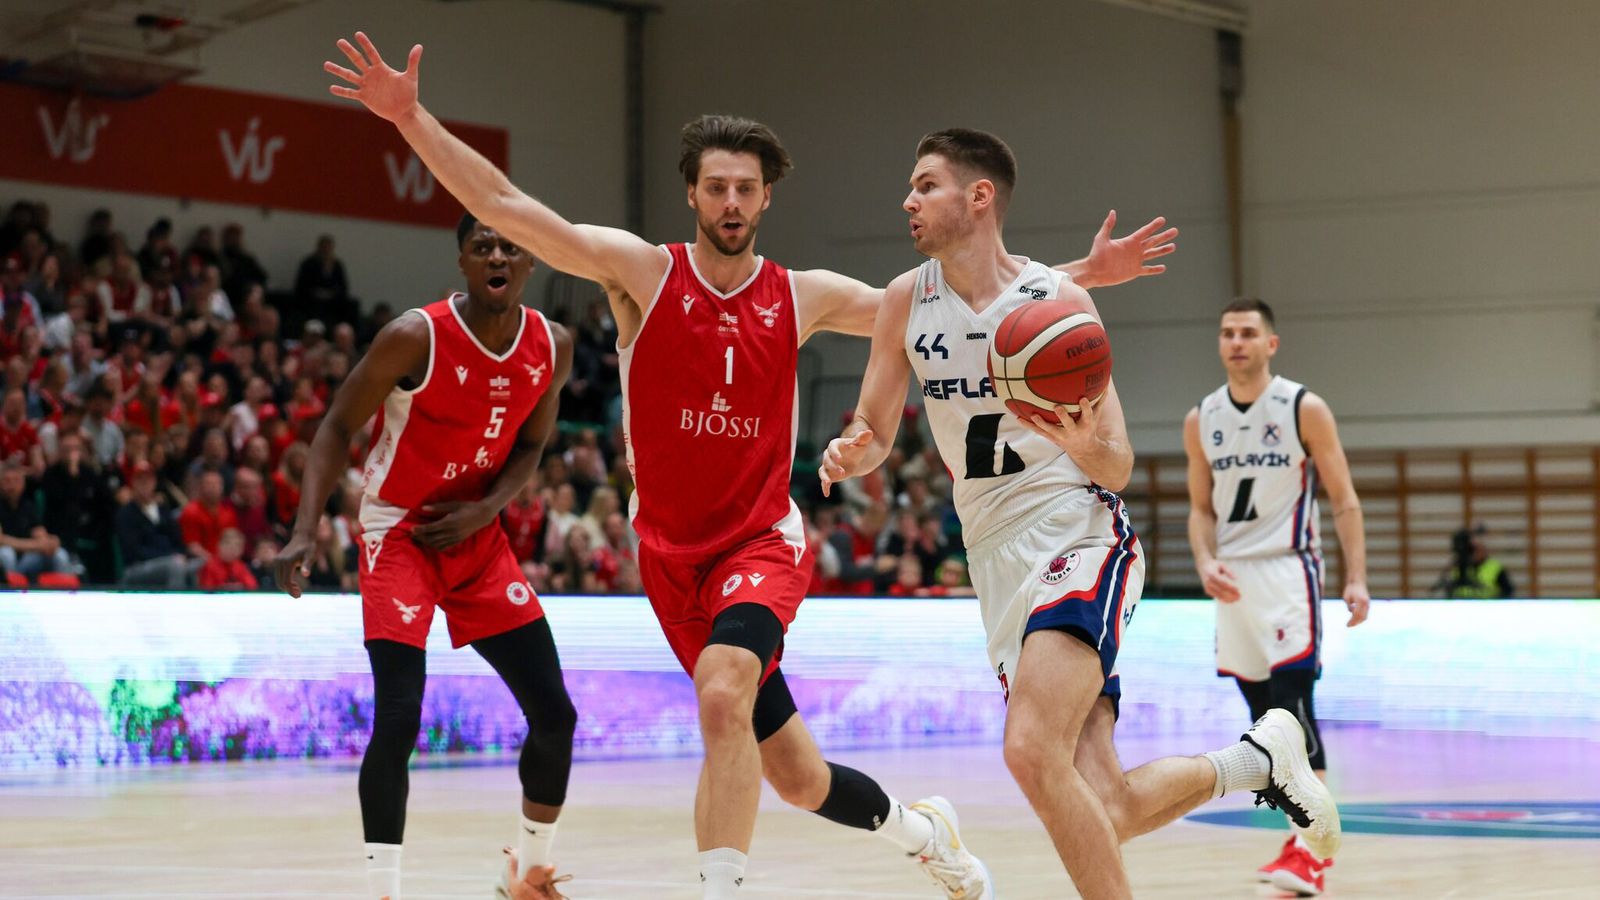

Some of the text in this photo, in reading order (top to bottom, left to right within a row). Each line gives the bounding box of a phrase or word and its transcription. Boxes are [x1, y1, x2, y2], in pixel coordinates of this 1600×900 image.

[1019, 285, 1048, 298] GEYSIR
[914, 333, 949, 361] 44
[1065, 336, 1105, 359] molten
[724, 346, 734, 385] 1
[923, 377, 998, 400] KEFLA
[483, 406, 507, 438] 5
[680, 408, 761, 438] BJOSSI
[1213, 430, 1223, 446] 9
